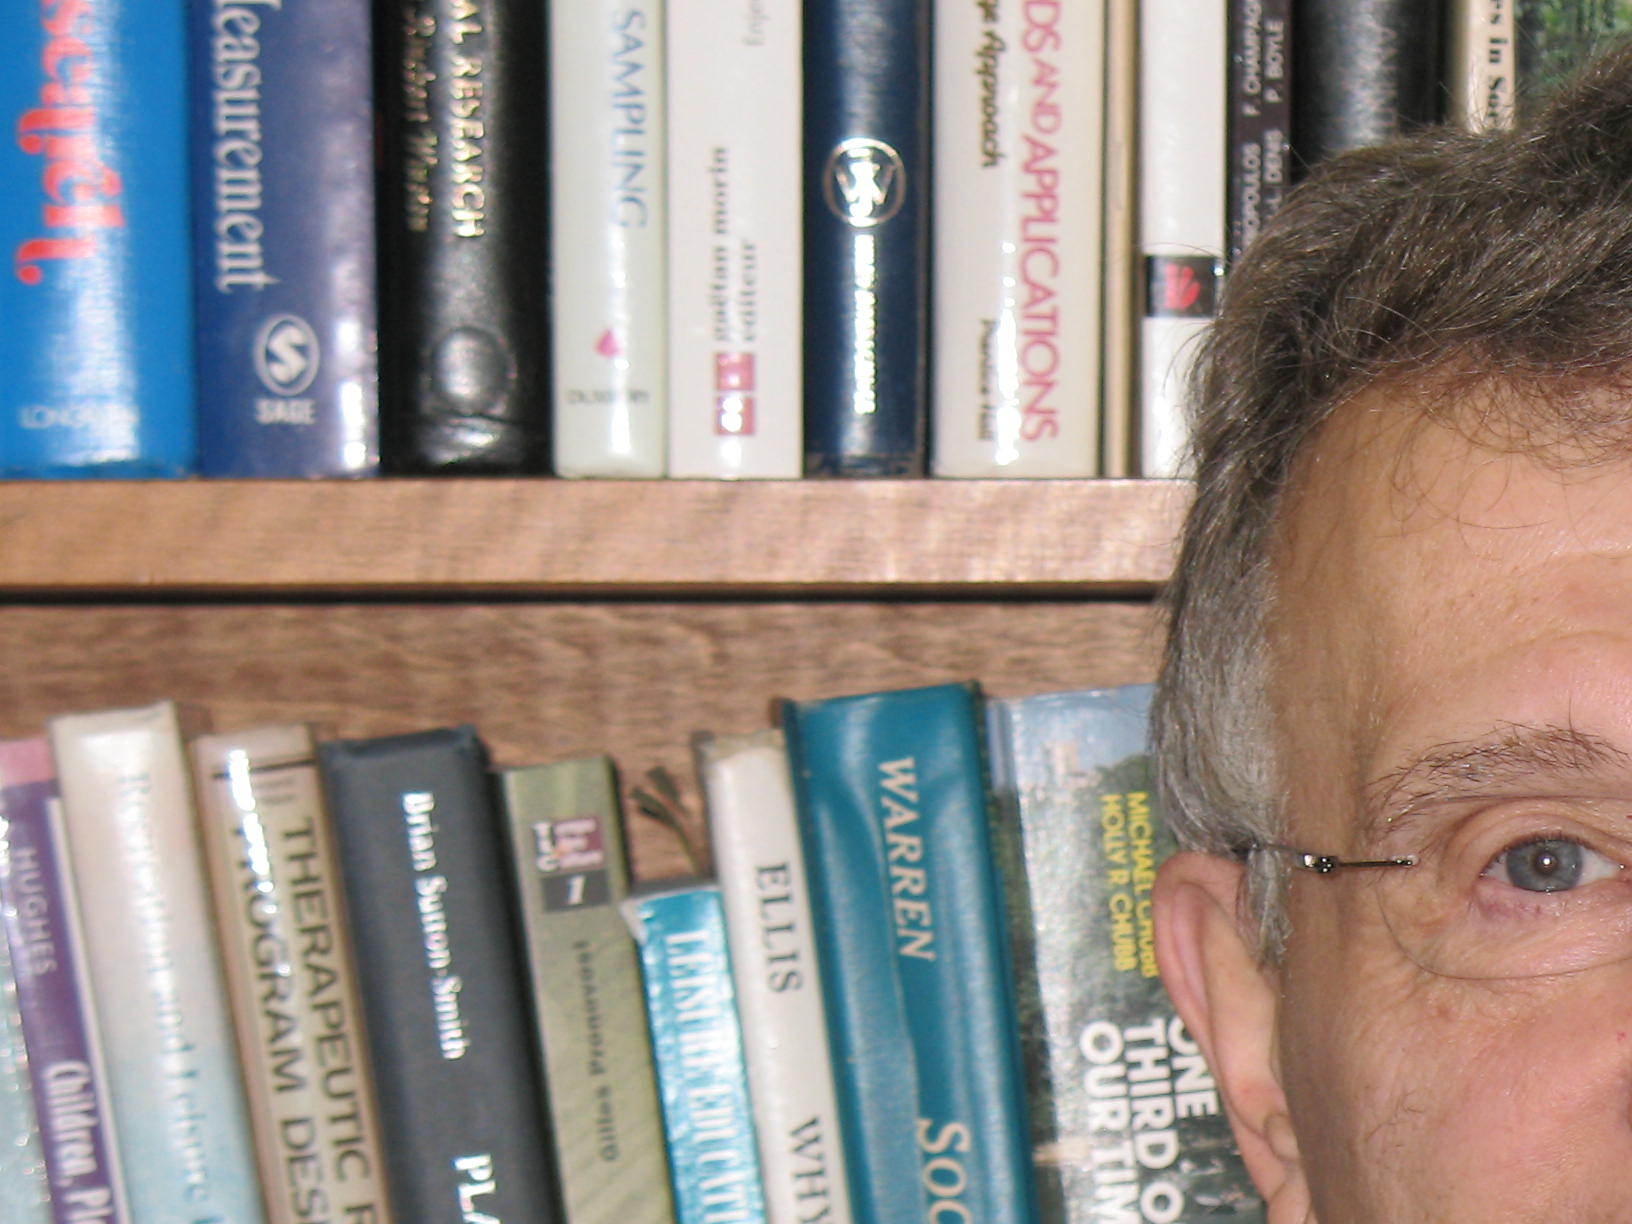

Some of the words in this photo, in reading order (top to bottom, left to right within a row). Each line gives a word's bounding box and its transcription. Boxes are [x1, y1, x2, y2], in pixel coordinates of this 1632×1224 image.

[975, 30, 1007, 168] Approach
[1031, 57, 1060, 134] AND
[1488, 37, 1508, 63] in
[211, 0, 282, 293] easurement
[451, 54, 485, 237] RESEARCH
[610, 8, 648, 229] SAMPLING
[1020, 135, 1060, 440] APPLICATIONS
[255, 399, 317, 425] SAGE
[401, 788, 446, 872] Brian
[875, 755, 938, 965] WARREN
[1097, 792, 1130, 866] HOLLY
[1121, 790, 1159, 895] MICHAEL
[12, 845, 59, 977] HUGHES
[752, 860, 805, 995] ELLIS
[1105, 891, 1142, 973] CHUBB
[277, 815, 371, 1185] THERAPEUTIC
[1163, 1010, 1221, 1119] ONE
[39, 1058, 108, 1188] Children,
[1074, 1017, 1136, 1135] OUR
[1116, 1015, 1184, 1172] THIRD
